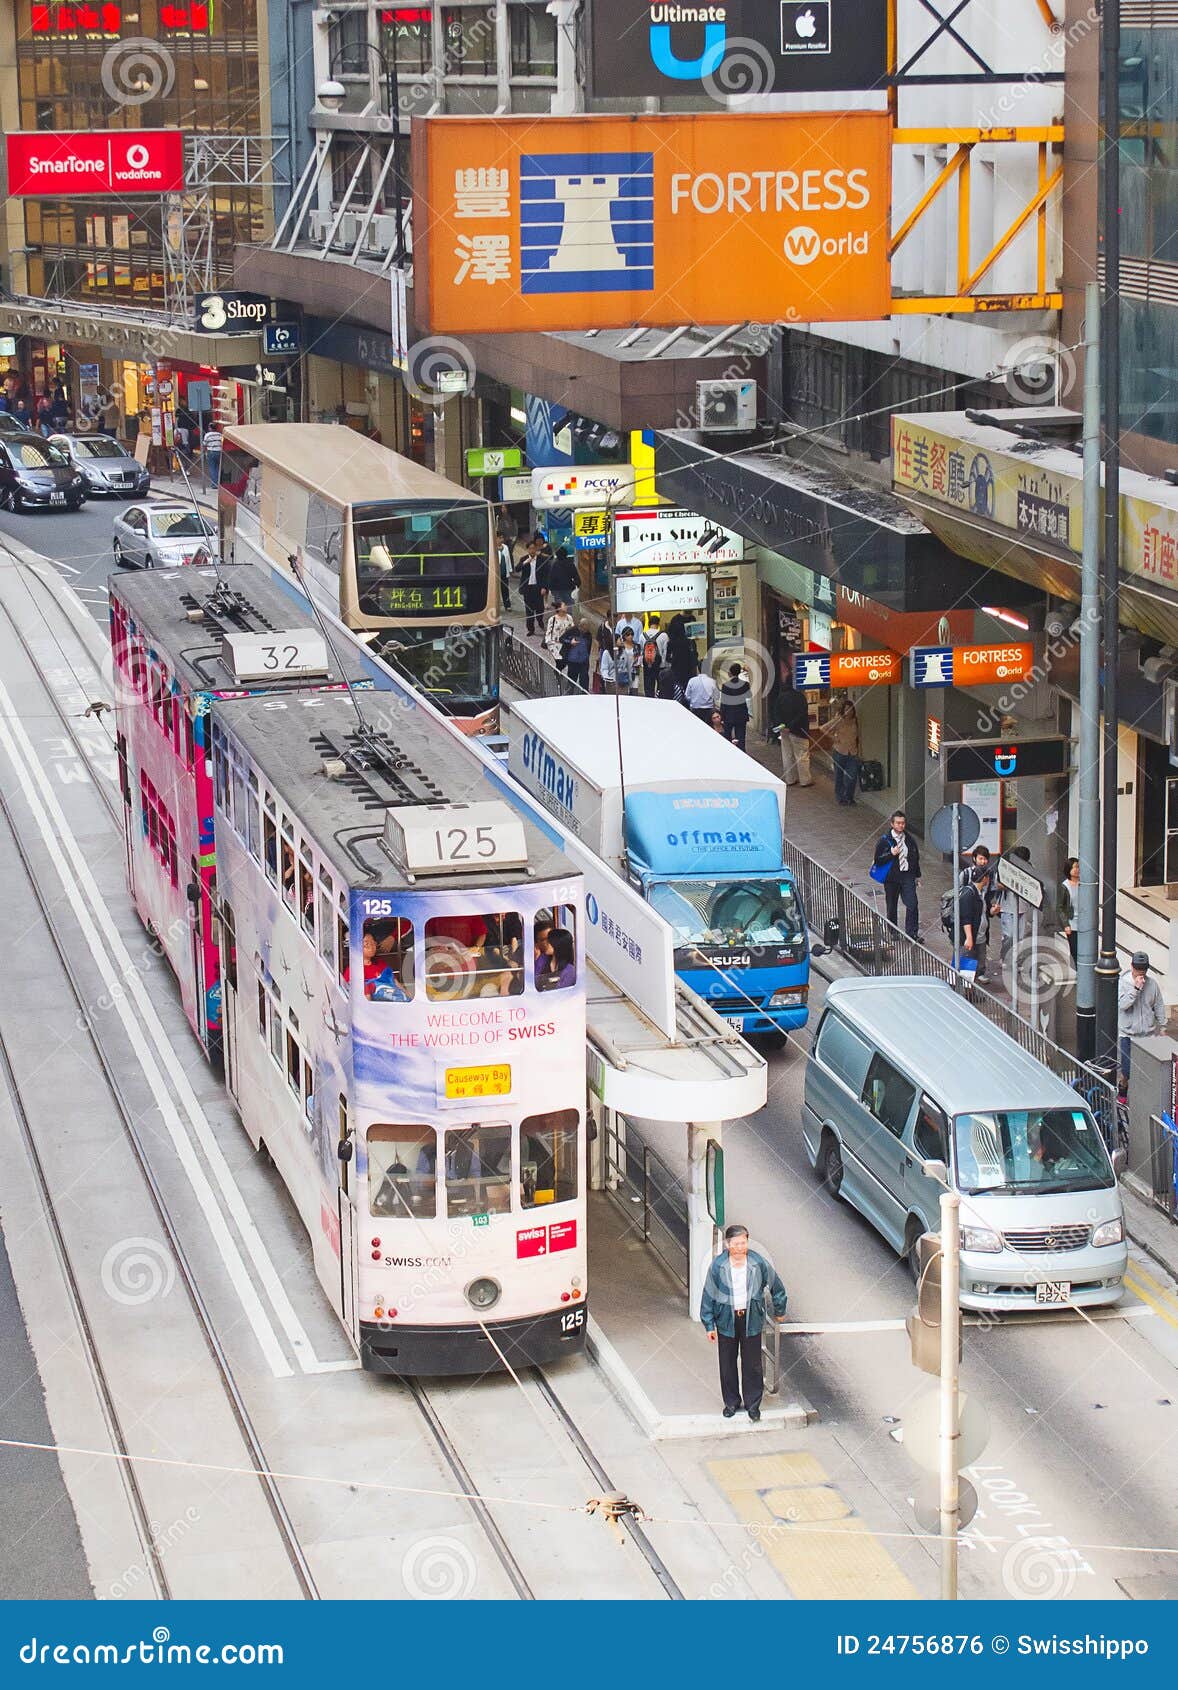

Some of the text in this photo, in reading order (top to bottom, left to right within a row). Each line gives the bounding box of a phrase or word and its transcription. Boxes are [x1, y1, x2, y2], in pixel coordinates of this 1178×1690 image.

[650, 4, 726, 22] Ultimate
[29, 156, 105, 175] SmarTone
[115, 169, 162, 181] vodafone
[671, 169, 870, 215] FORTRESS
[453, 167, 511, 285] 豐澤
[784, 226, 869, 266] World
[227, 300, 267, 322] Shop
[896, 429, 966, 505] 佳美餐廳
[584, 478, 619, 488] PCCW
[1143, 520, 1178, 585] 訂座
[391, 588, 422, 602] 坪石
[432, 586, 464, 608] 111
[261, 645, 299, 670] 32
[838, 654, 892, 669] FORTRESS
[963, 648, 1023, 664] FORTRESS
[996, 665, 1023, 678] World
[523, 733, 574, 812] offmax
[436, 826, 497, 861] 125
[667, 830, 752, 846] offmax
[551, 886, 578, 902] 125
[362, 899, 392, 915] 125
[708, 955, 751, 966] ISUZU
[426, 1007, 526, 1028] WELCOME TO
[390, 1022, 556, 1048] THE WORLD OF SWISS
[447, 1070, 508, 1084] Causeway Bay
[518, 1229, 545, 1241] swiss
[560, 1309, 584, 1331] 125
[967, 1466, 1041, 1517] LOOK
